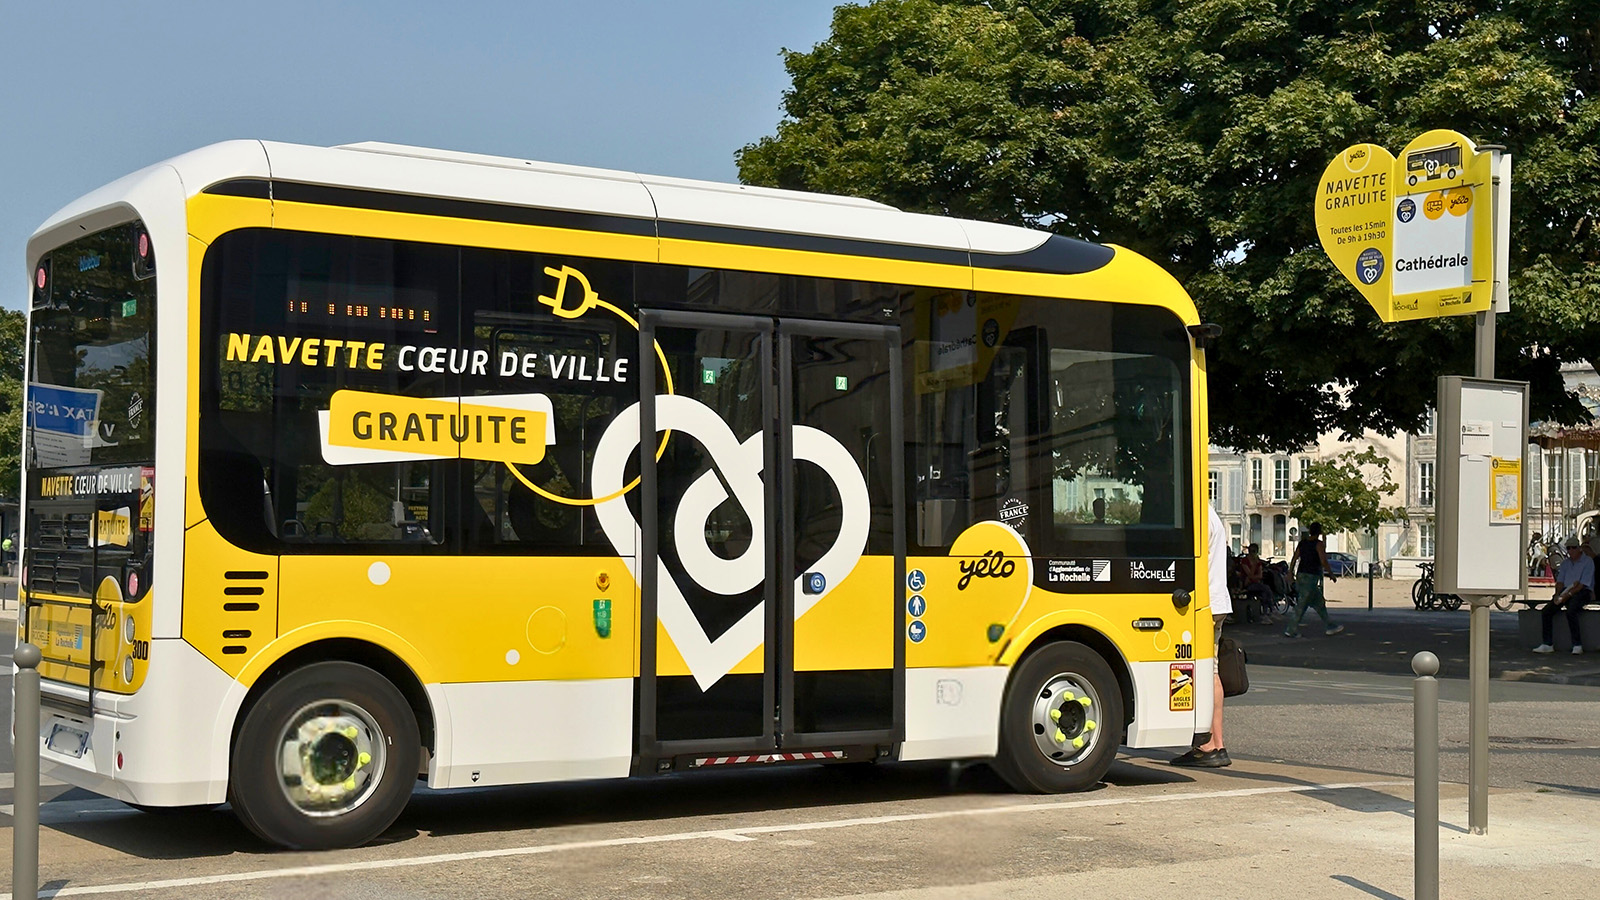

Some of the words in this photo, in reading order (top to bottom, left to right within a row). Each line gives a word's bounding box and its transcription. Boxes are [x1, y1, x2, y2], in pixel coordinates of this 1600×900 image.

[1325, 172, 1387, 195] NAVETTE
[1325, 190, 1387, 210] GRATUITE
[1330, 226, 1352, 235] Toutes
[1353, 224, 1363, 232] les
[1365, 220, 1386, 230] 15min
[1337, 237, 1346, 245] De
[1347, 235, 1356, 244] 9h
[1364, 230, 1386, 241] 19h30
[1395, 253, 1469, 272] Cathédrale
[226, 332, 386, 370] NAVETTE
[398, 345, 488, 377] CŒUR
[499, 351, 539, 379] DE
[549, 354, 630, 383] VILLE
[352, 410, 528, 444] GRATUITE
[41, 475, 73, 497] NAVETTE
[74, 474, 96, 495] CŒUR
[97, 474, 109, 494] DE
[110, 473, 133, 494] VILLE
[99, 519, 126, 536] RATUITE
[957, 549, 1016, 591] yélo
[1133, 561, 1145, 570] LA
[1133, 570, 1176, 579] ROCHELLE
[1048, 573, 1058, 582] La
[1059, 572, 1091, 582] Rochelle
[132, 639, 149, 661] 300
[1175, 643, 1192, 659] 300
